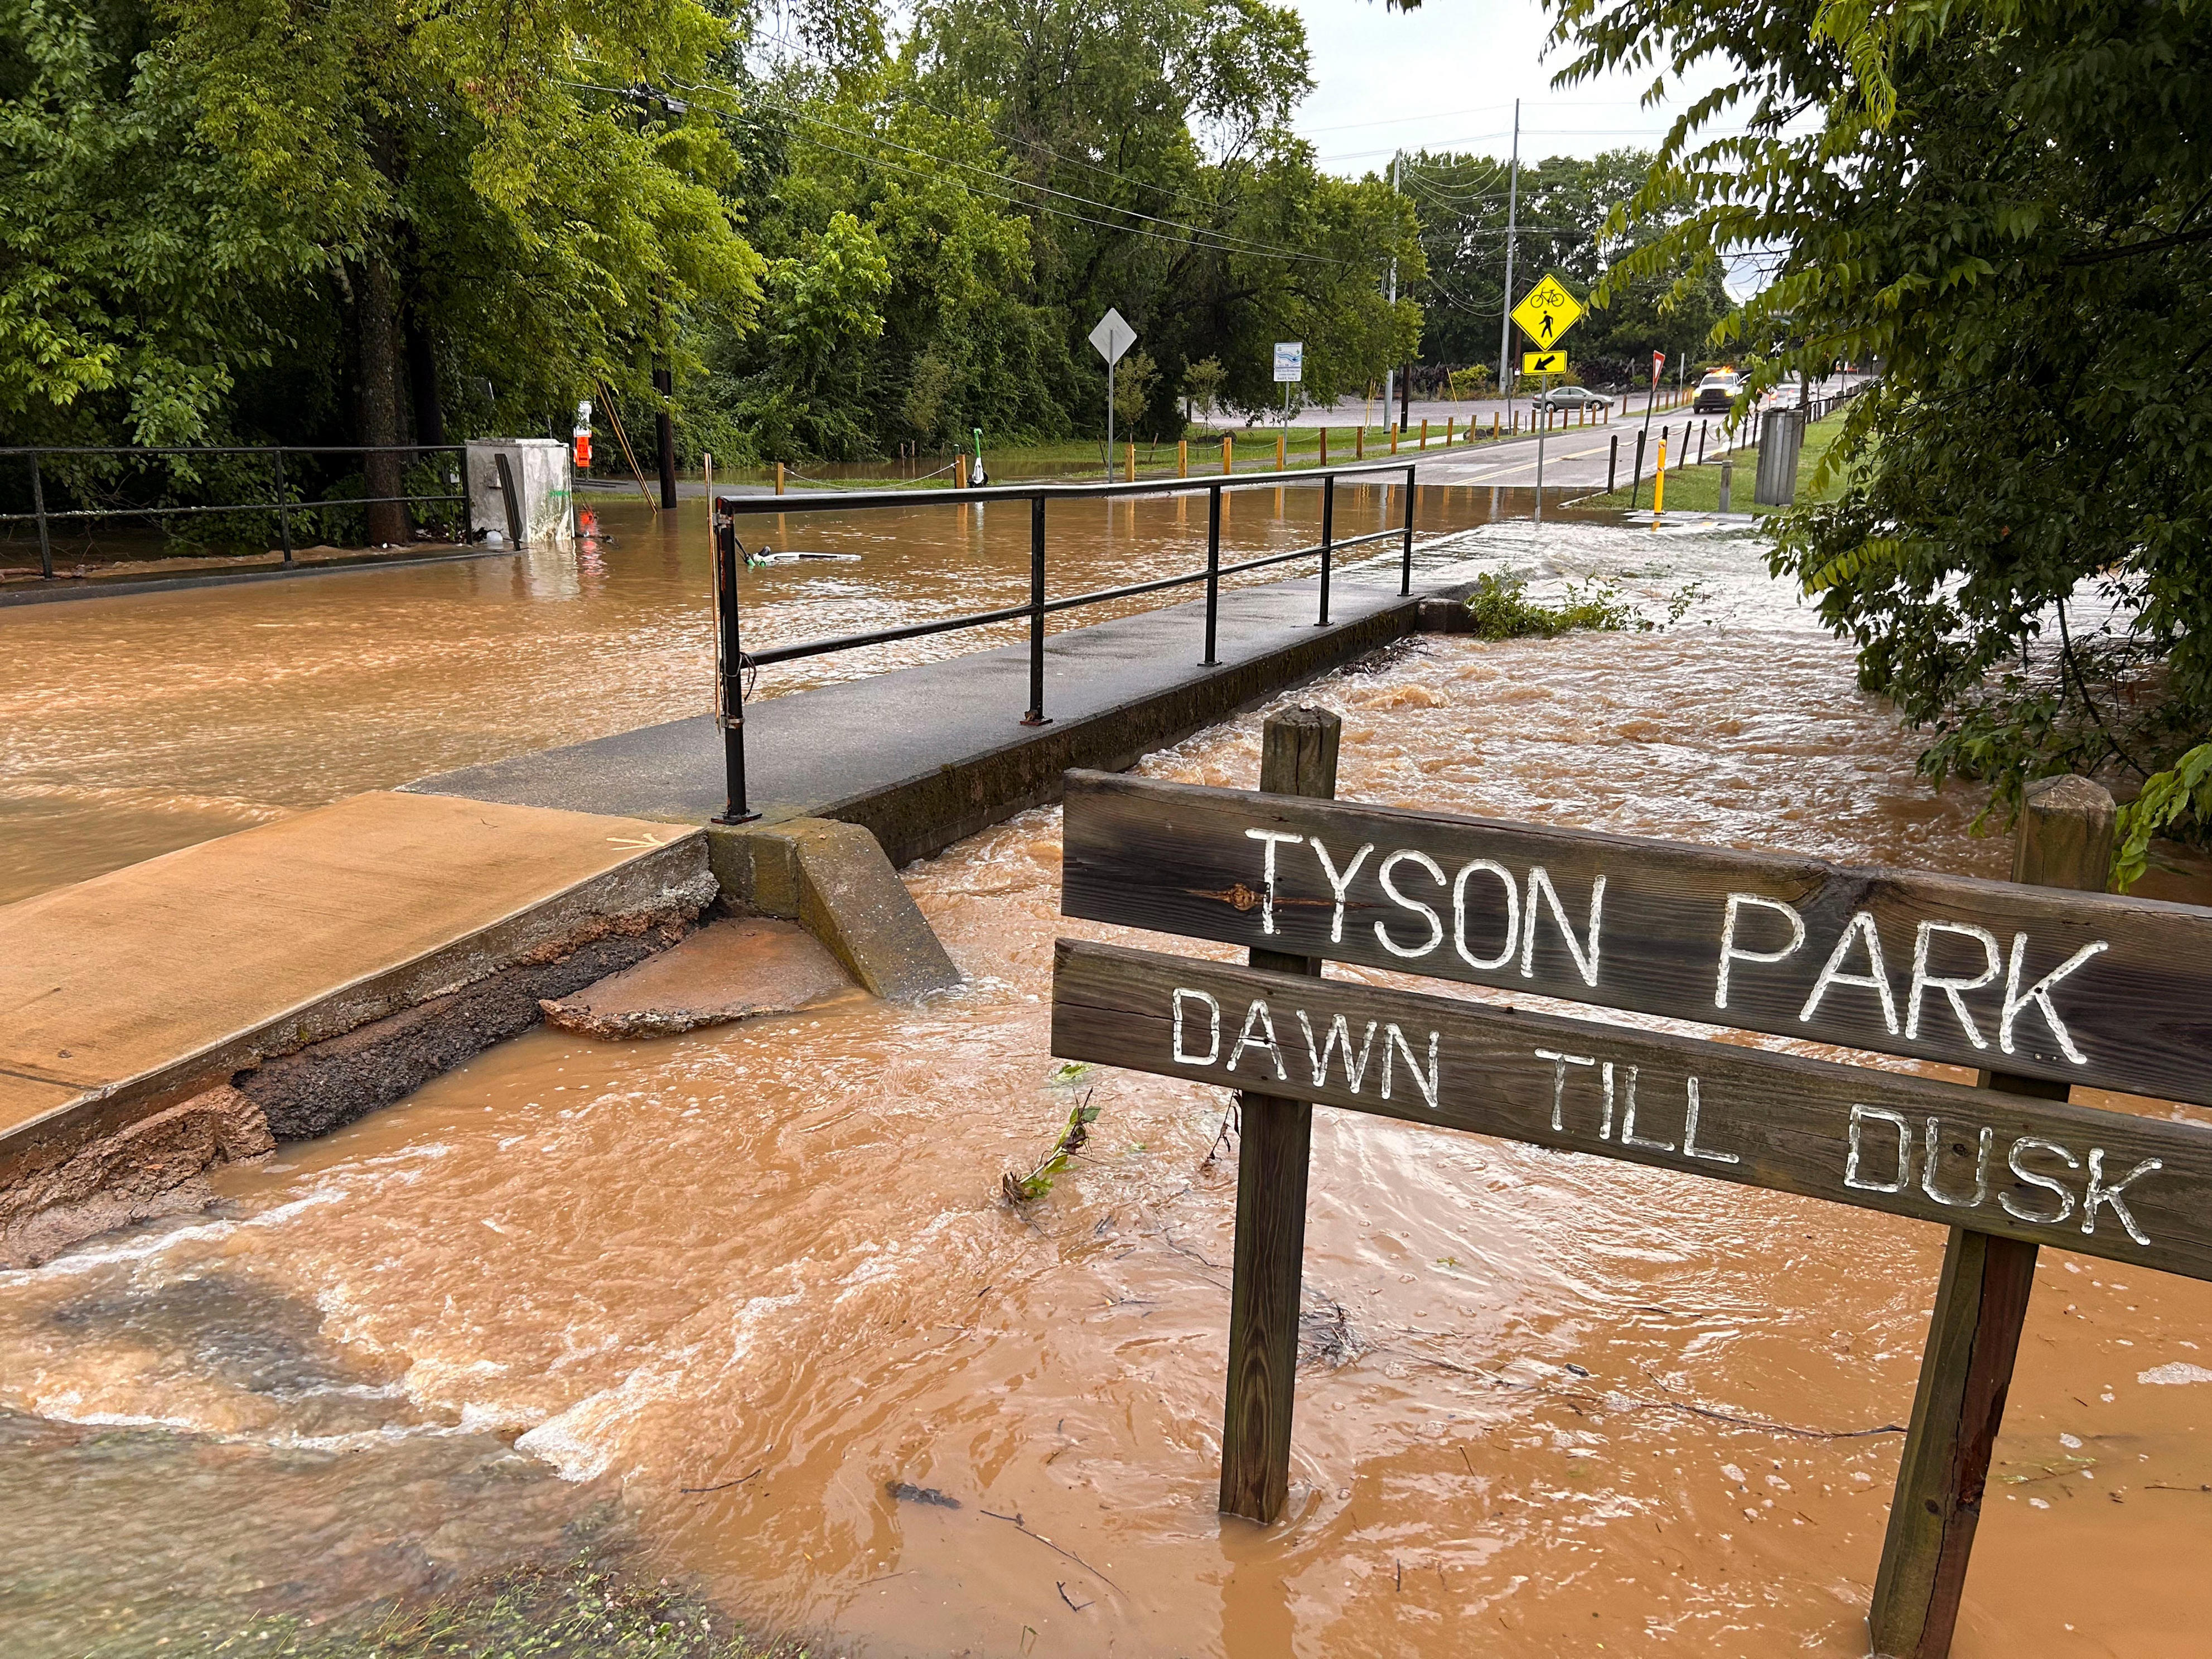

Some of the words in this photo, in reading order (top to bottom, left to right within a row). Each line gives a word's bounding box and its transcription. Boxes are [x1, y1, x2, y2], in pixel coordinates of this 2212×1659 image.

[1246, 828, 1607, 987] TYSON
[1714, 893, 2109, 1064] PARK
[1172, 987, 1439, 1108] DAWN
[1534, 1048, 1741, 1164] TILL
[1844, 1103, 2162, 1246] DUSK
